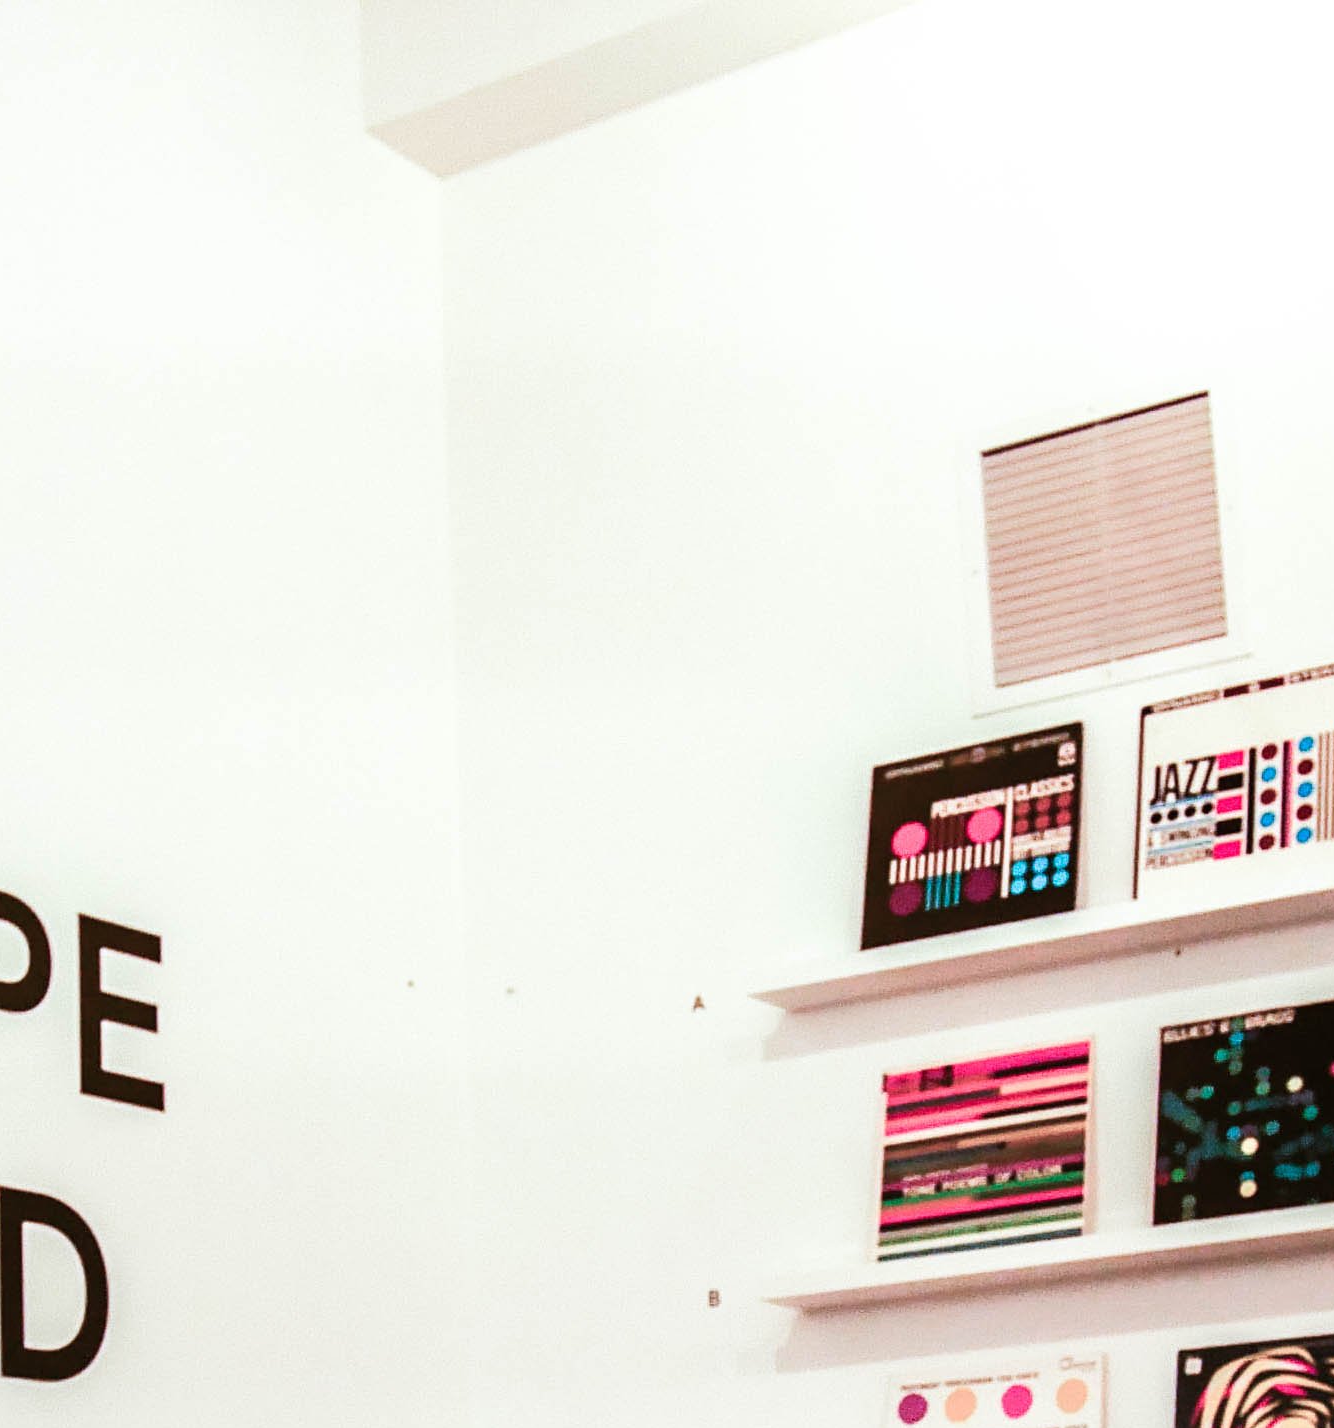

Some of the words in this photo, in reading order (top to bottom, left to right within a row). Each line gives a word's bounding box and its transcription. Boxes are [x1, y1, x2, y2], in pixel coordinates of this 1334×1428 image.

[1014, 774, 1074, 801] CLASSICS
[1150, 755, 1218, 807] JAZZ
[693, 996, 704, 1011] A
[709, 1290, 720, 1307] B
